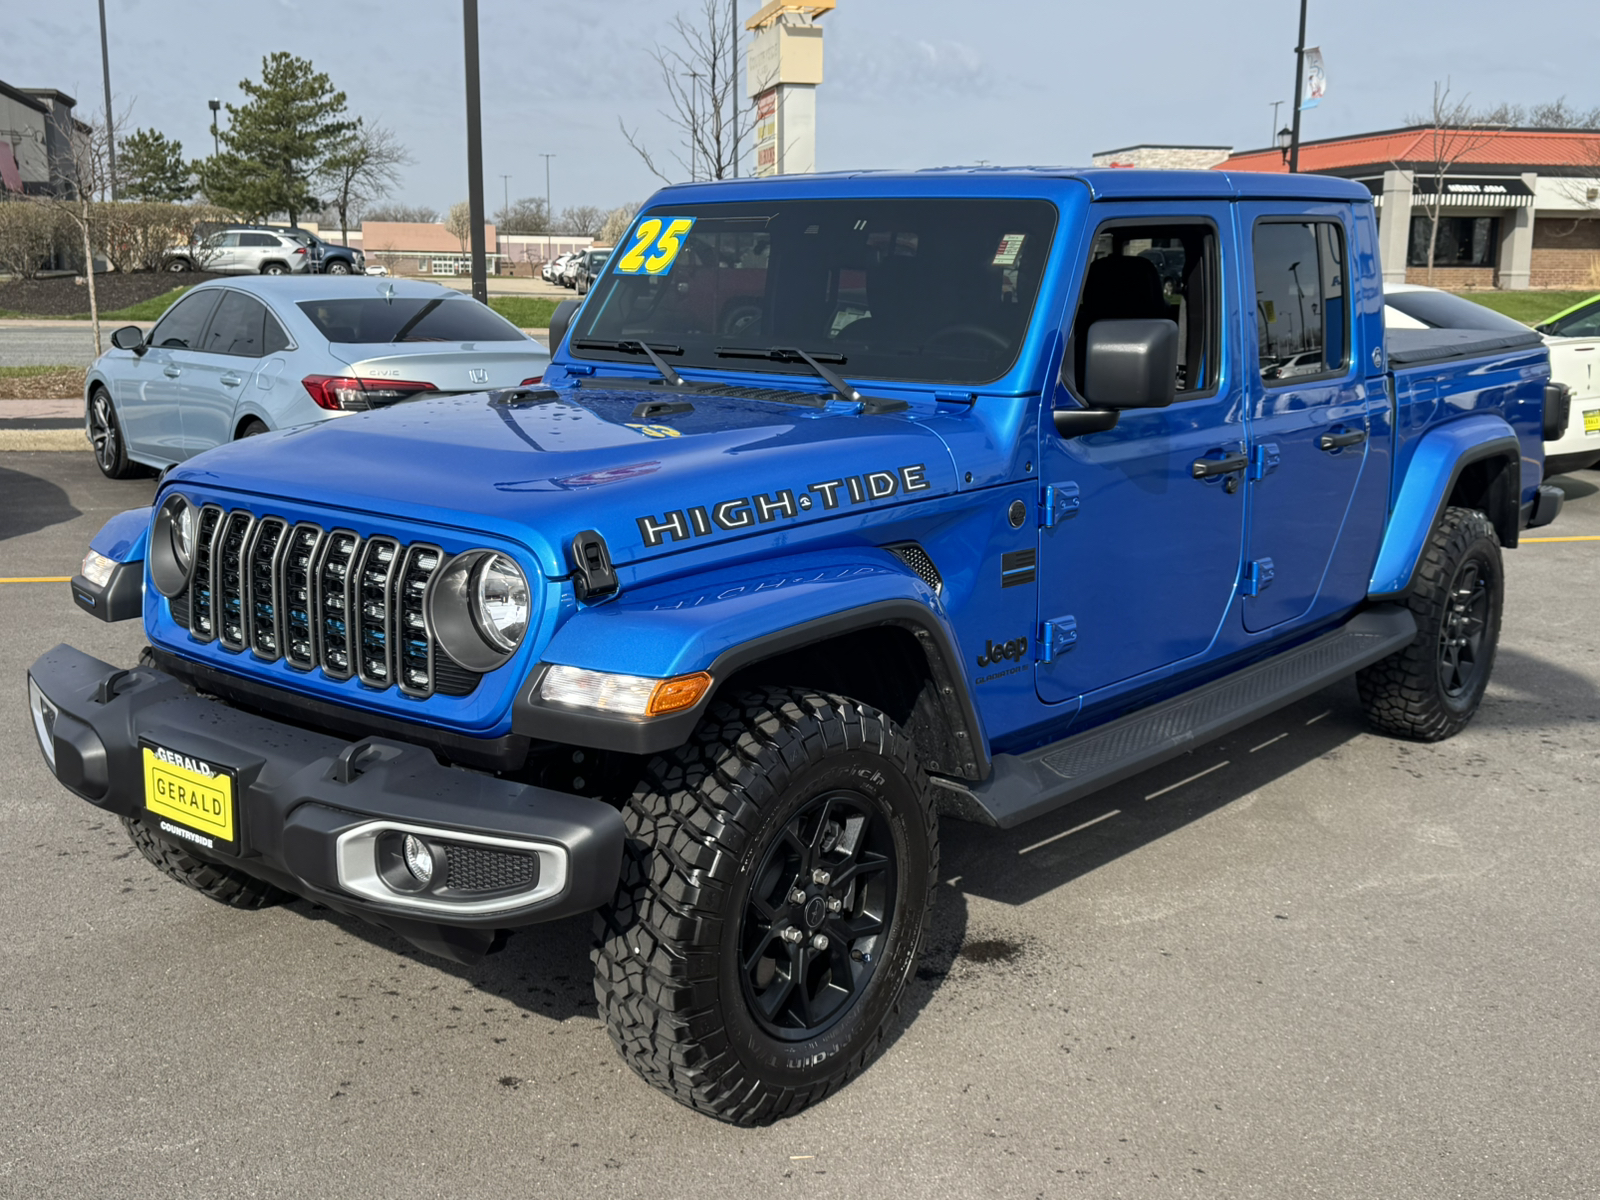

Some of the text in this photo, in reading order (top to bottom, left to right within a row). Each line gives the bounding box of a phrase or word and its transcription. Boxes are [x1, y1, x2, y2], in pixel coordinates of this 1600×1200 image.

[618, 218, 692, 273] 25
[636, 463, 931, 547] HIGH TIDE
[977, 636, 1028, 668] Jeep
[975, 665, 1021, 685] GLADIATOR
[156, 747, 211, 776] GERALD
[157, 778, 222, 815] GERALD
[160, 821, 213, 848] COUNTRYSIDE
